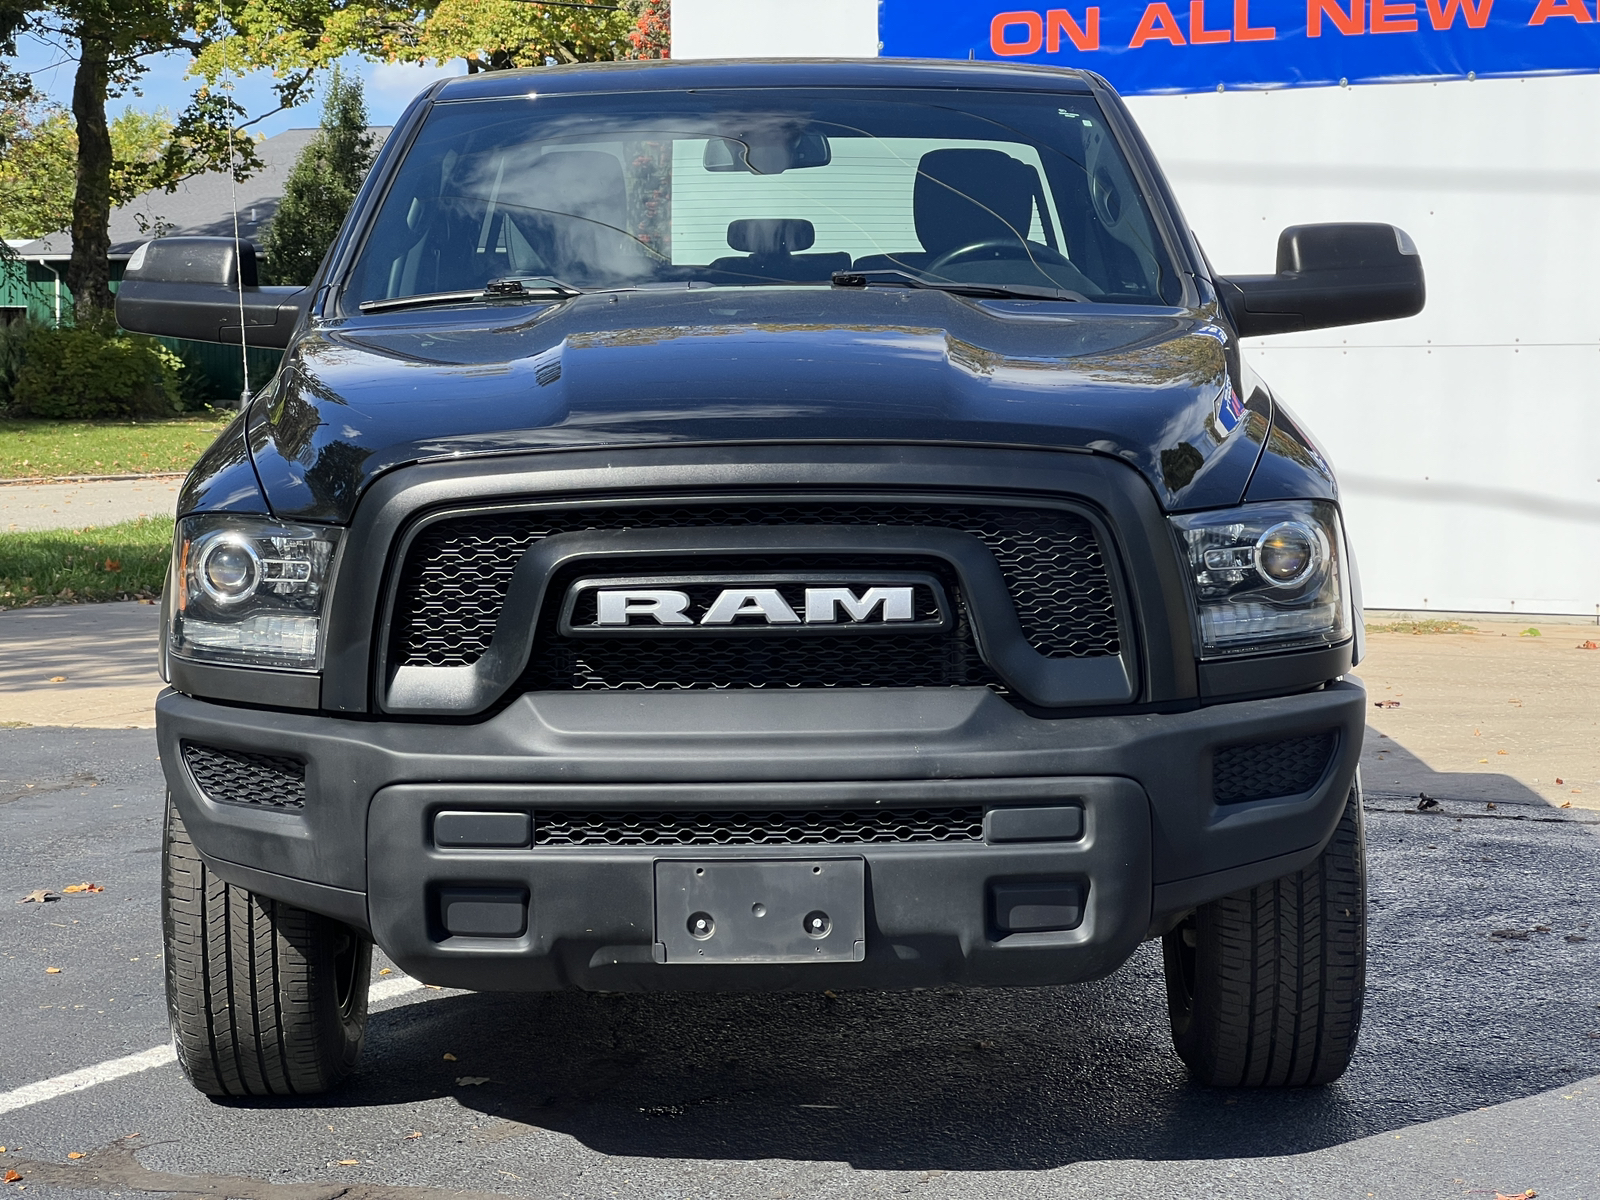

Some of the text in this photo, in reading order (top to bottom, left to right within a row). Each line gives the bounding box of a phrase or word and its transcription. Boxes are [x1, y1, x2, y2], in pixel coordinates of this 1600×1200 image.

[990, 0, 1600, 56] ON ALL NEW A
[597, 587, 915, 625] RAM
